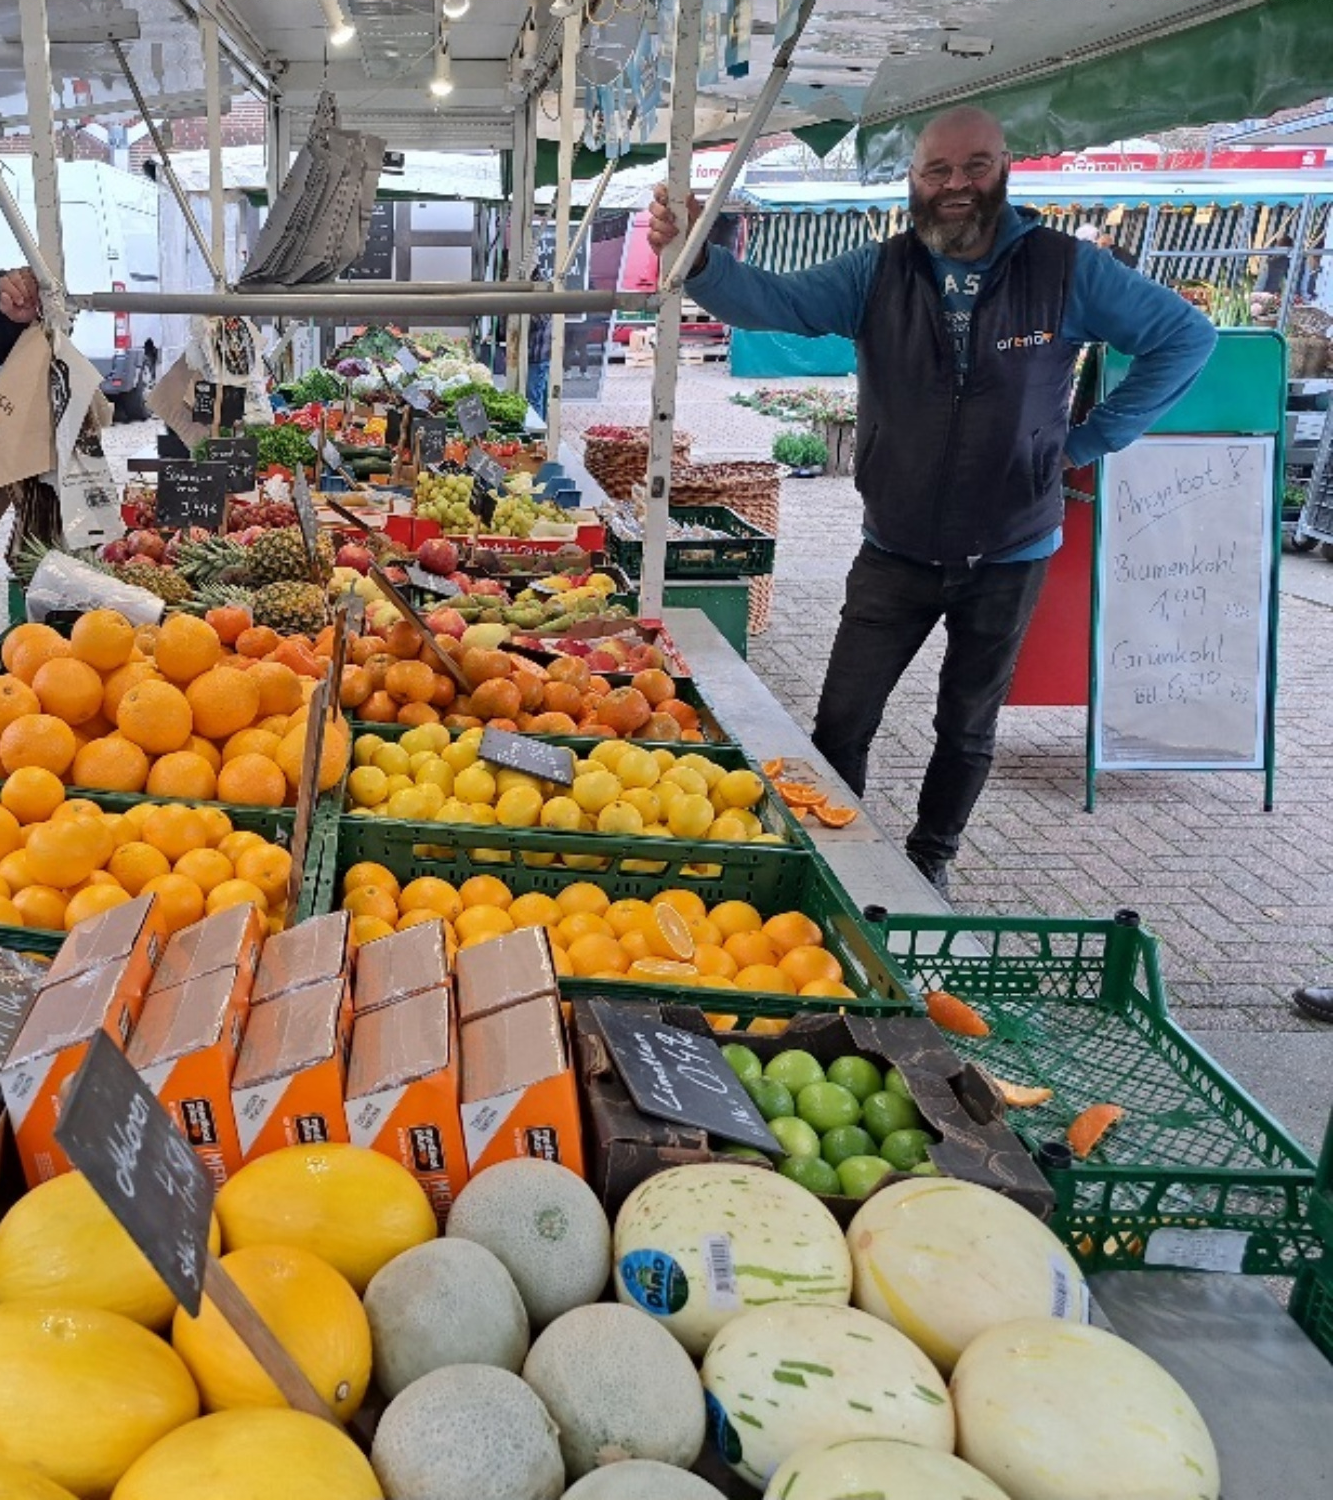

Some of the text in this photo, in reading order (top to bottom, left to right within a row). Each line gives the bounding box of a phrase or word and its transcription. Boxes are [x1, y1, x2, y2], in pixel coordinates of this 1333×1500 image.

[943, 273, 982, 296] AS
[1114, 541, 1237, 583] Blumenkohl
[1110, 633, 1225, 670] Grünkohl
